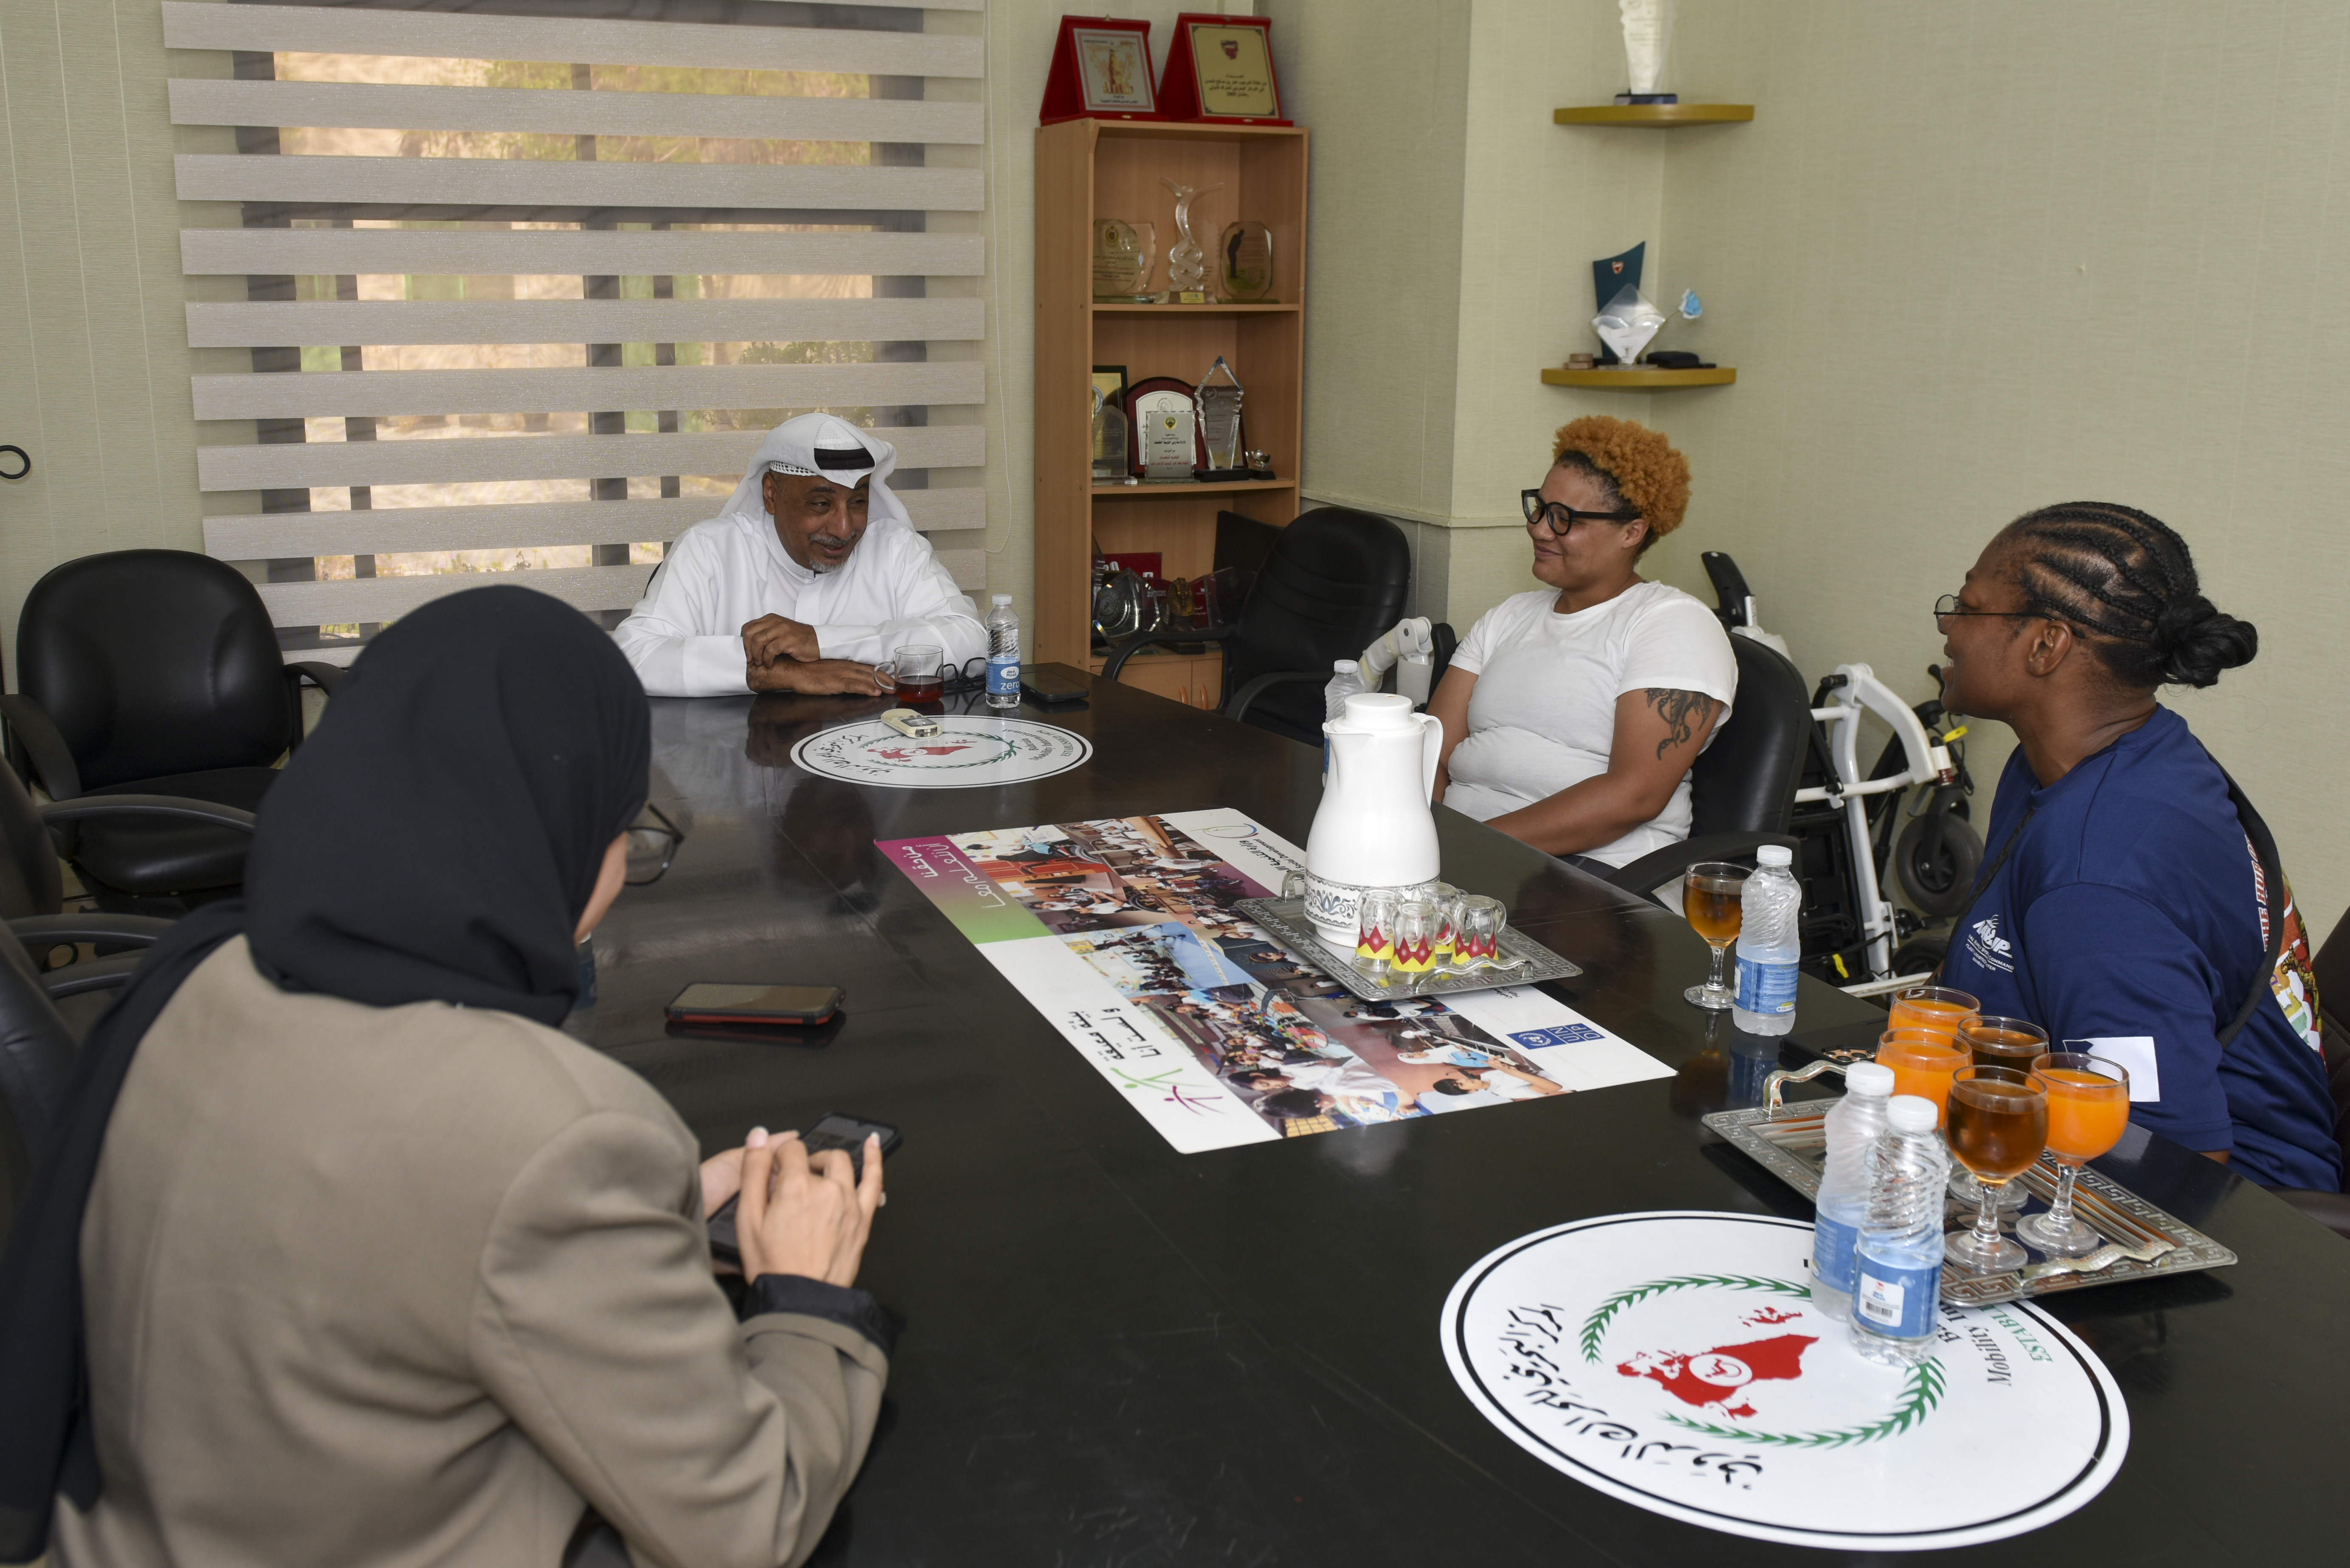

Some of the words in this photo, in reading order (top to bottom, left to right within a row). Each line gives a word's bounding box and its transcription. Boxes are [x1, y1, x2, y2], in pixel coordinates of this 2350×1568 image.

[1000, 681, 1019, 690] zero
[1002, 729, 1052, 746] International
[1020, 738, 1039, 751] Bahrain
[1053, 735, 1074, 756] ESTABLISHED
[1028, 747, 1056, 761] Mobility
[1239, 840, 1258, 850] وزارة
[1250, 850, 1281, 866] التنمية
[1253, 839, 1289, 859] Development
[912, 858, 938, 877] حقنا
[1283, 859, 1304, 868] Social
[2251, 860, 2266, 906] HUB
[2258, 907, 2270, 953] THE
[1988, 955, 2014, 970] COMMAND
[1068, 1011, 1092, 1029] بيئة
[1087, 1032, 1126, 1061] معيقة
[1550, 1027, 1579, 1042] UN
[1573, 1026, 1601, 1040] DP
[1507, 1304, 1565, 1344] المركز
[1977, 1304, 2054, 1362] ESTABLI
[1499, 1331, 1570, 1386] البحريني
[1964, 1325, 2012, 1387] Mobility
[1524, 1390, 1638, 1441] للحراك
